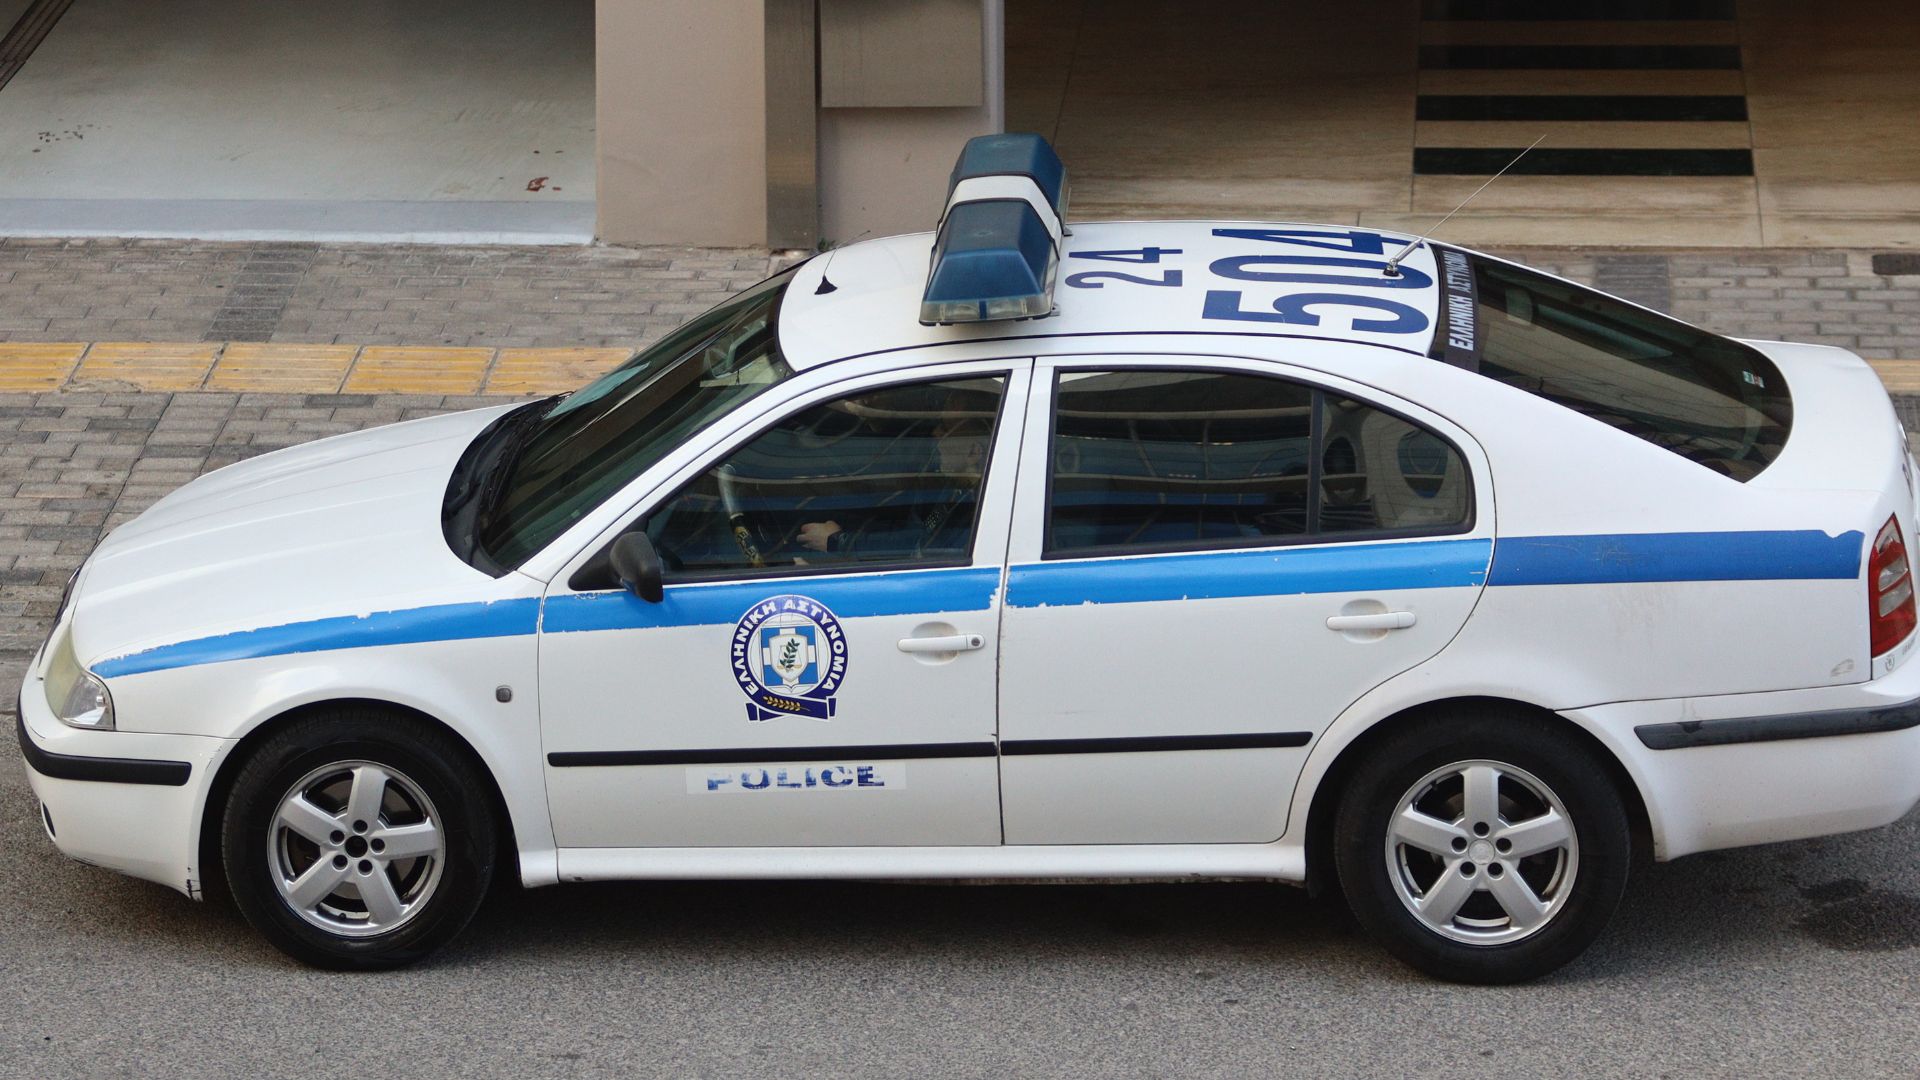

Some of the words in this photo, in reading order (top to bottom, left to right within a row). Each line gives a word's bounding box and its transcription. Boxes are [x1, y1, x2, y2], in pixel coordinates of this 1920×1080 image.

[1065, 247, 1183, 289] 24
[1202, 229, 1433, 334] 504
[1448, 294, 1474, 351] ΕΛΛΗΝΙΚΗ
[733, 601, 777, 695] ΕΛΛΗΝΙΚΗ
[784, 600, 846, 690] ΑΣΤΥΝΟΜΙΑ
